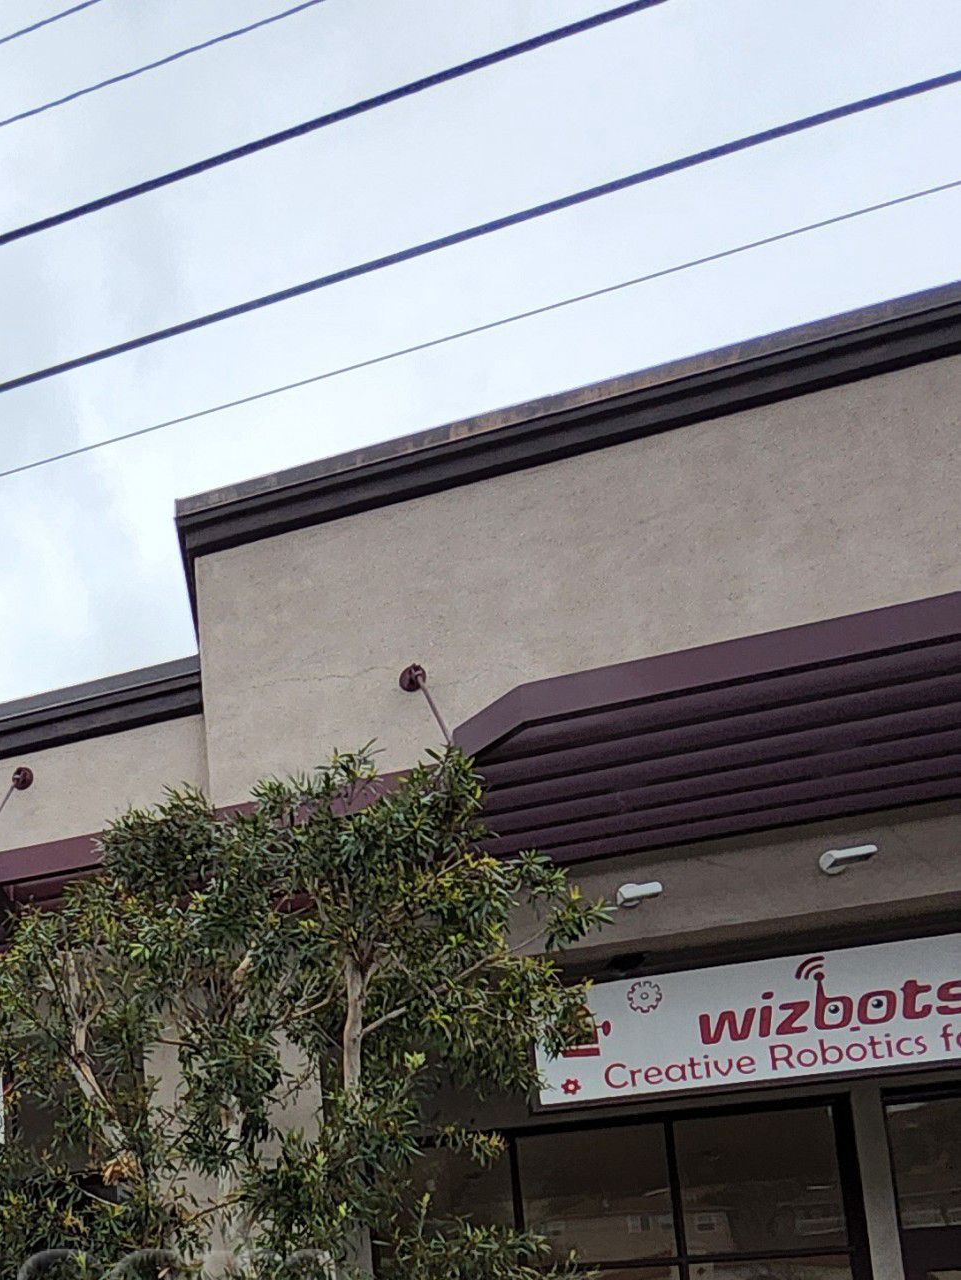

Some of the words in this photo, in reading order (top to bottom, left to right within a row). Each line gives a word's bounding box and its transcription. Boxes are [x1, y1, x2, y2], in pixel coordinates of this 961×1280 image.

[698, 972, 961, 1045] wizbots
[604, 1054, 757, 1089] Creative
[768, 1032, 928, 1071] Robotics
[940, 1023, 961, 1052] f
